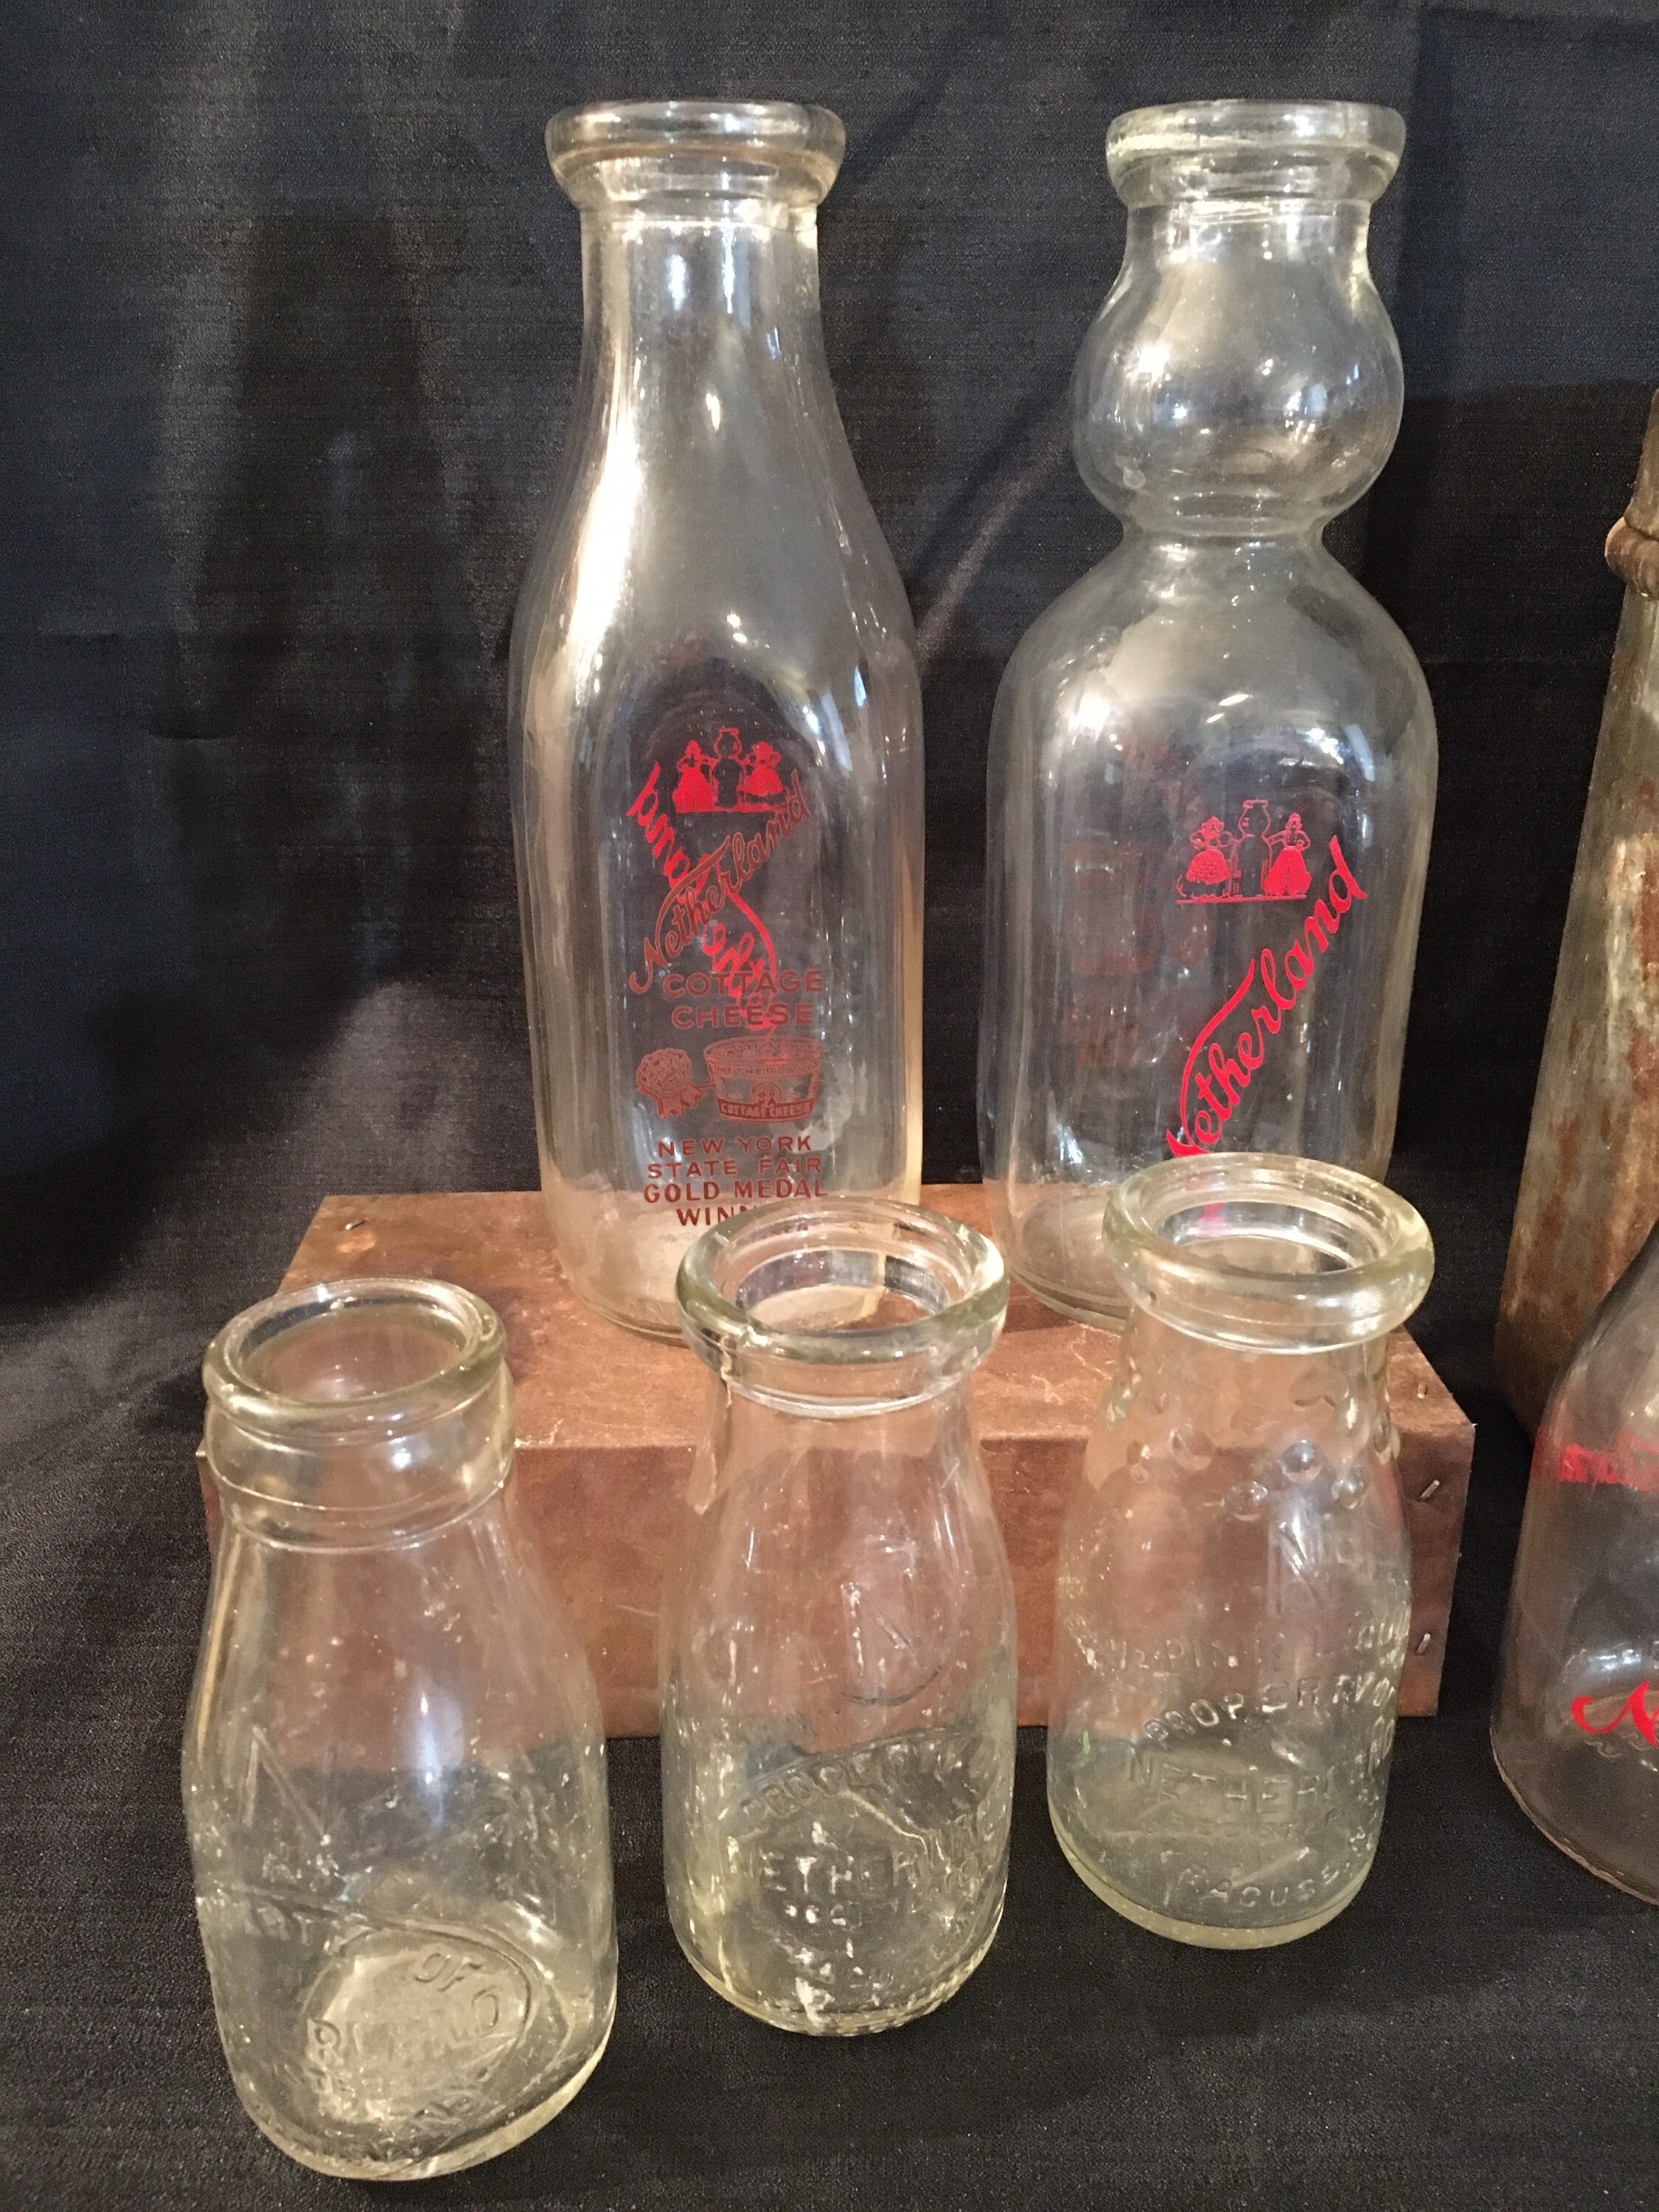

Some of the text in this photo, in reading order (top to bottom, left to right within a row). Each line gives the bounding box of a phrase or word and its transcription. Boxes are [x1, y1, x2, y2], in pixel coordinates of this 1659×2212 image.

[629, 768, 810, 993] Netherland
[663, 969, 824, 998] COTTAGE
[671, 1002, 815, 1030] CHEESE
[720, 1103, 812, 1119] COTTAGE CHEESE
[658, 1135, 812, 1158] NEW YORK
[647, 1156, 823, 1180] STATE FAIR
[642, 1178, 829, 1203] GOLD MEDAL
[676, 1205, 757, 1227] WIN
